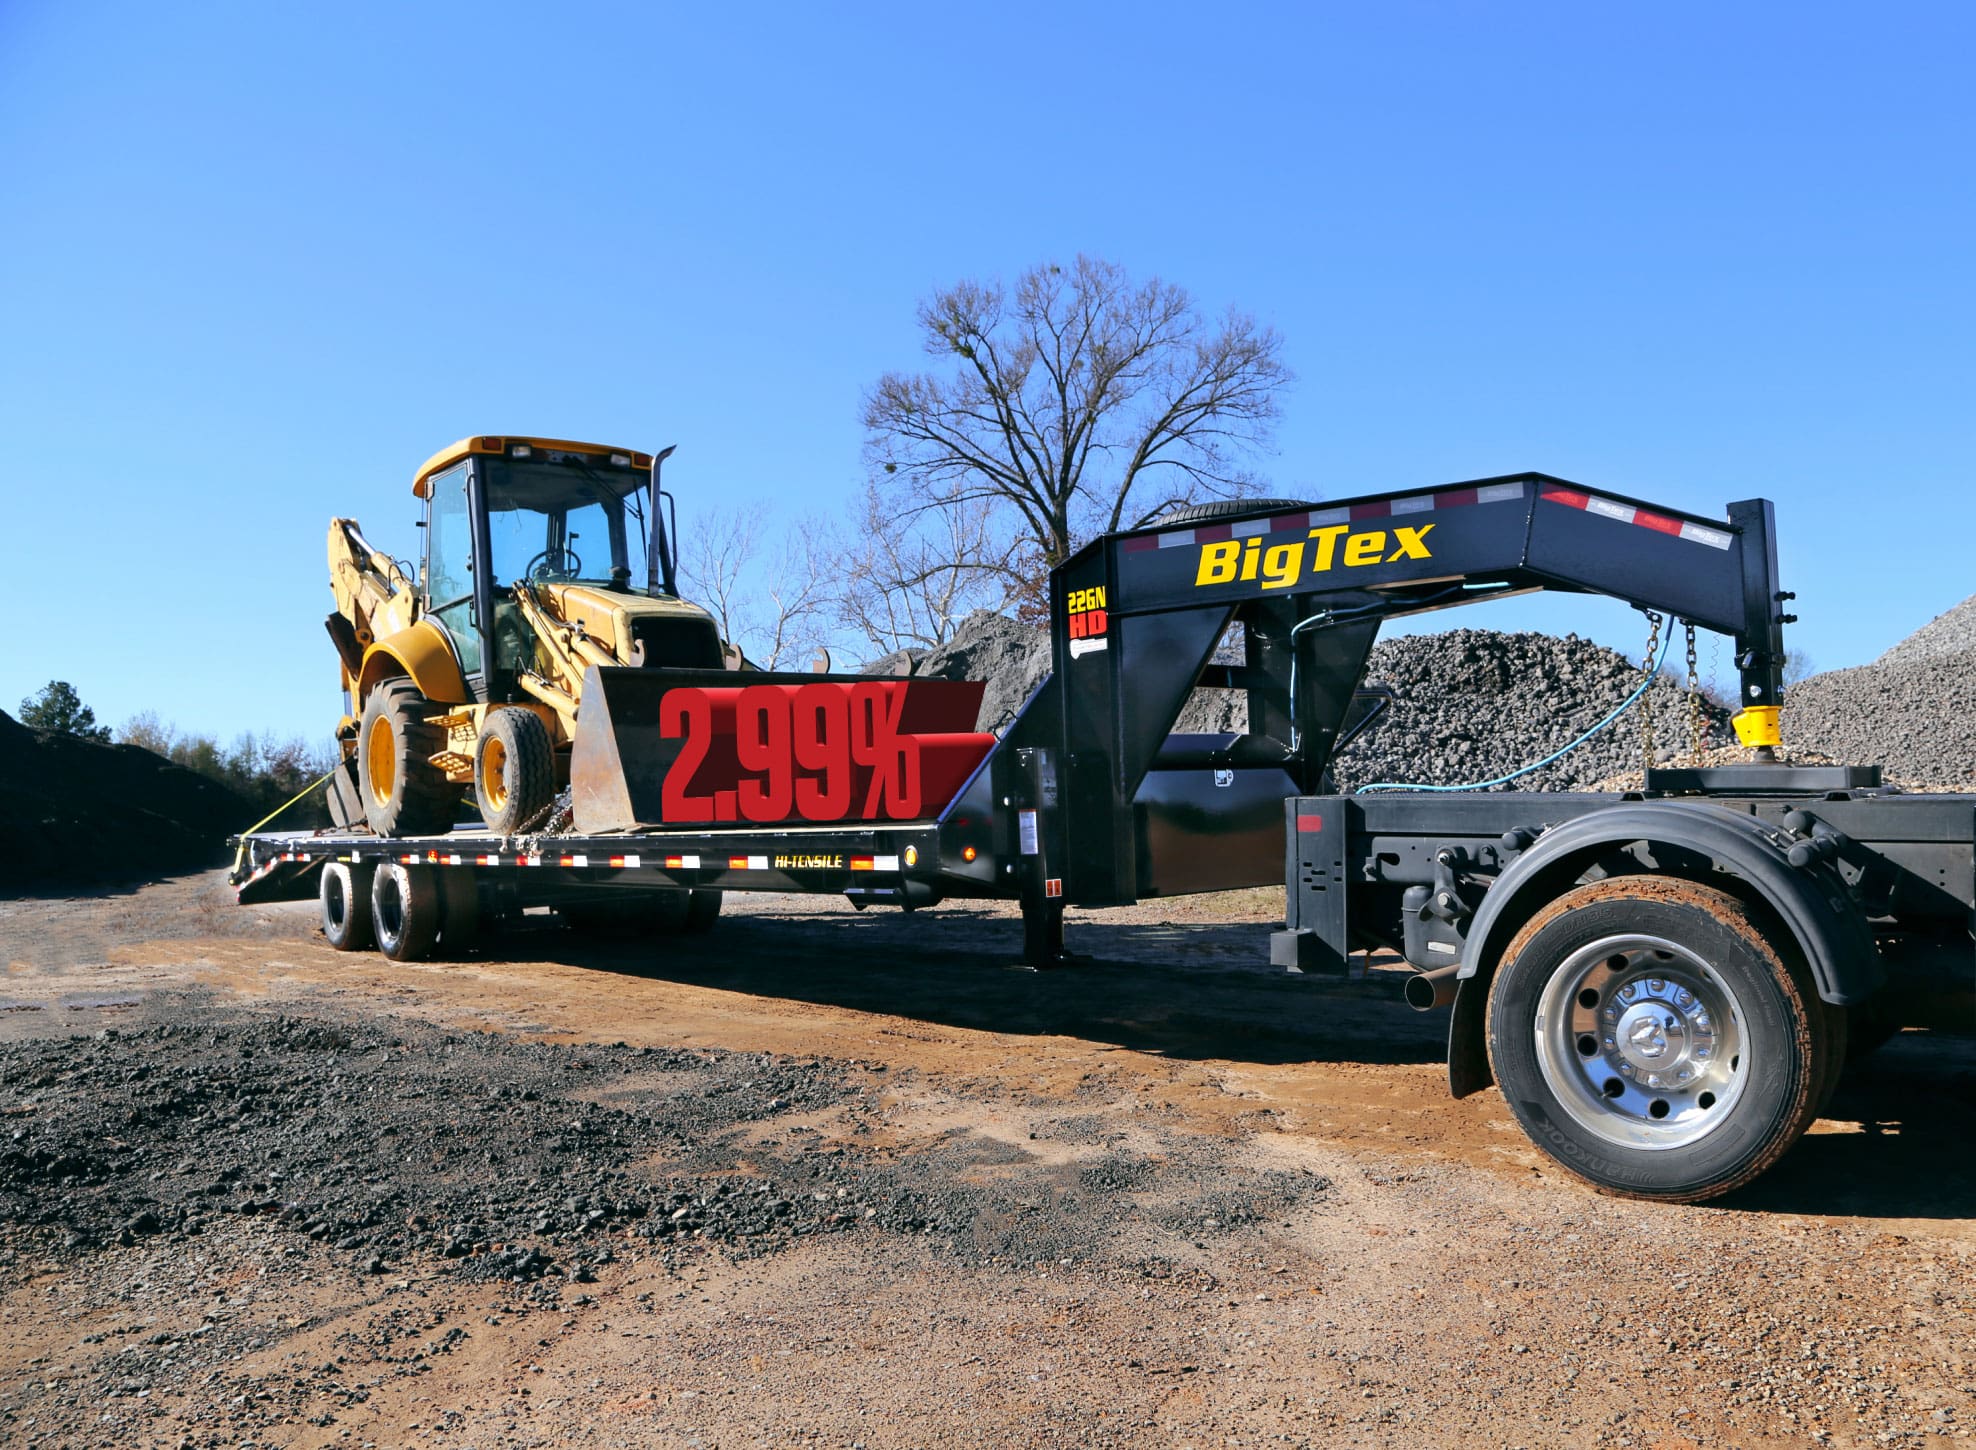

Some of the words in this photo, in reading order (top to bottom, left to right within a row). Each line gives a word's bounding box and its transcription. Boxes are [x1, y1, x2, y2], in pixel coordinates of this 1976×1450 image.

[1067, 585, 1106, 614] 226N
[1069, 609, 1107, 639] HD
[774, 854, 843, 869] HI-TENSILE
